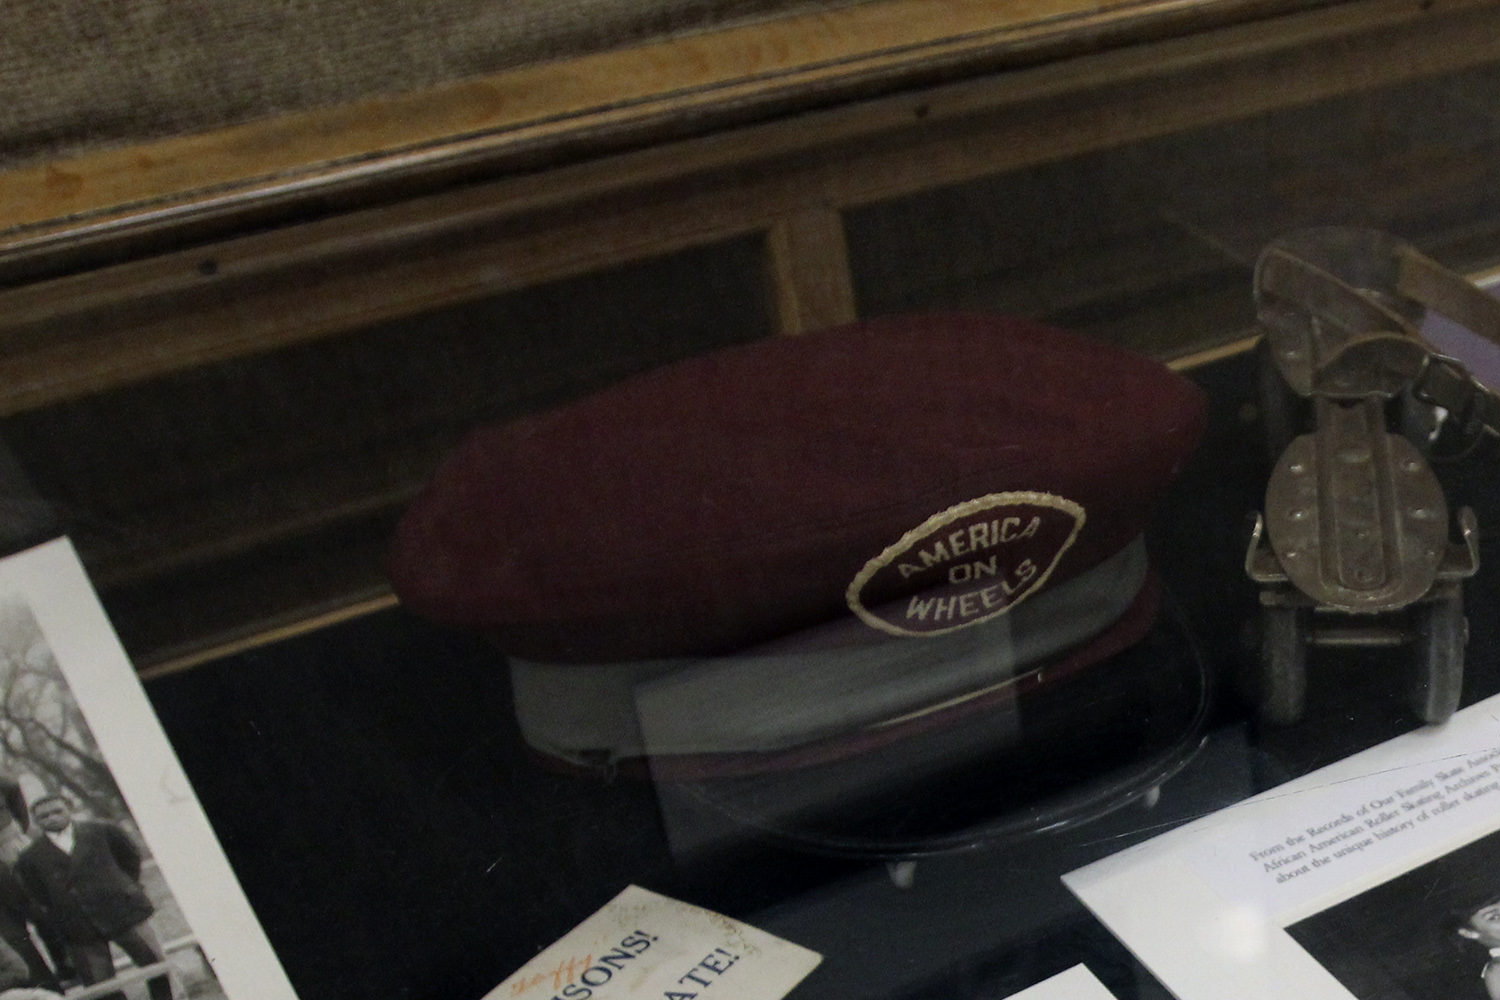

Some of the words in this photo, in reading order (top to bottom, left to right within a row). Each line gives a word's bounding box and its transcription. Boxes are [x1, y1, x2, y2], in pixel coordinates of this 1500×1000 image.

[898, 516, 1041, 578] AMERICA
[949, 555, 998, 583] ON
[906, 558, 1037, 621] WHEELS
[1250, 842, 1285, 861] From
[1285, 833, 1306, 848] the
[1306, 813, 1354, 837] Records
[1356, 804, 1369, 817] of
[1369, 796, 1395, 810] Our
[1395, 778, 1435, 798] Family
[1435, 766, 1464, 782] Skate
[1263, 850, 1307, 873] African
[1308, 825, 1364, 854] American
[1364, 808, 1401, 828] Roller
[1400, 790, 1446, 813] Skating
[1444, 769, 1491, 794] Archives
[1275, 865, 1311, 885] about
[1311, 854, 1332, 868] the
[1333, 838, 1374, 859] unique
[1372, 819, 1415, 842] history
[1416, 810, 1430, 822] of
[1432, 798, 1461, 816] roller
